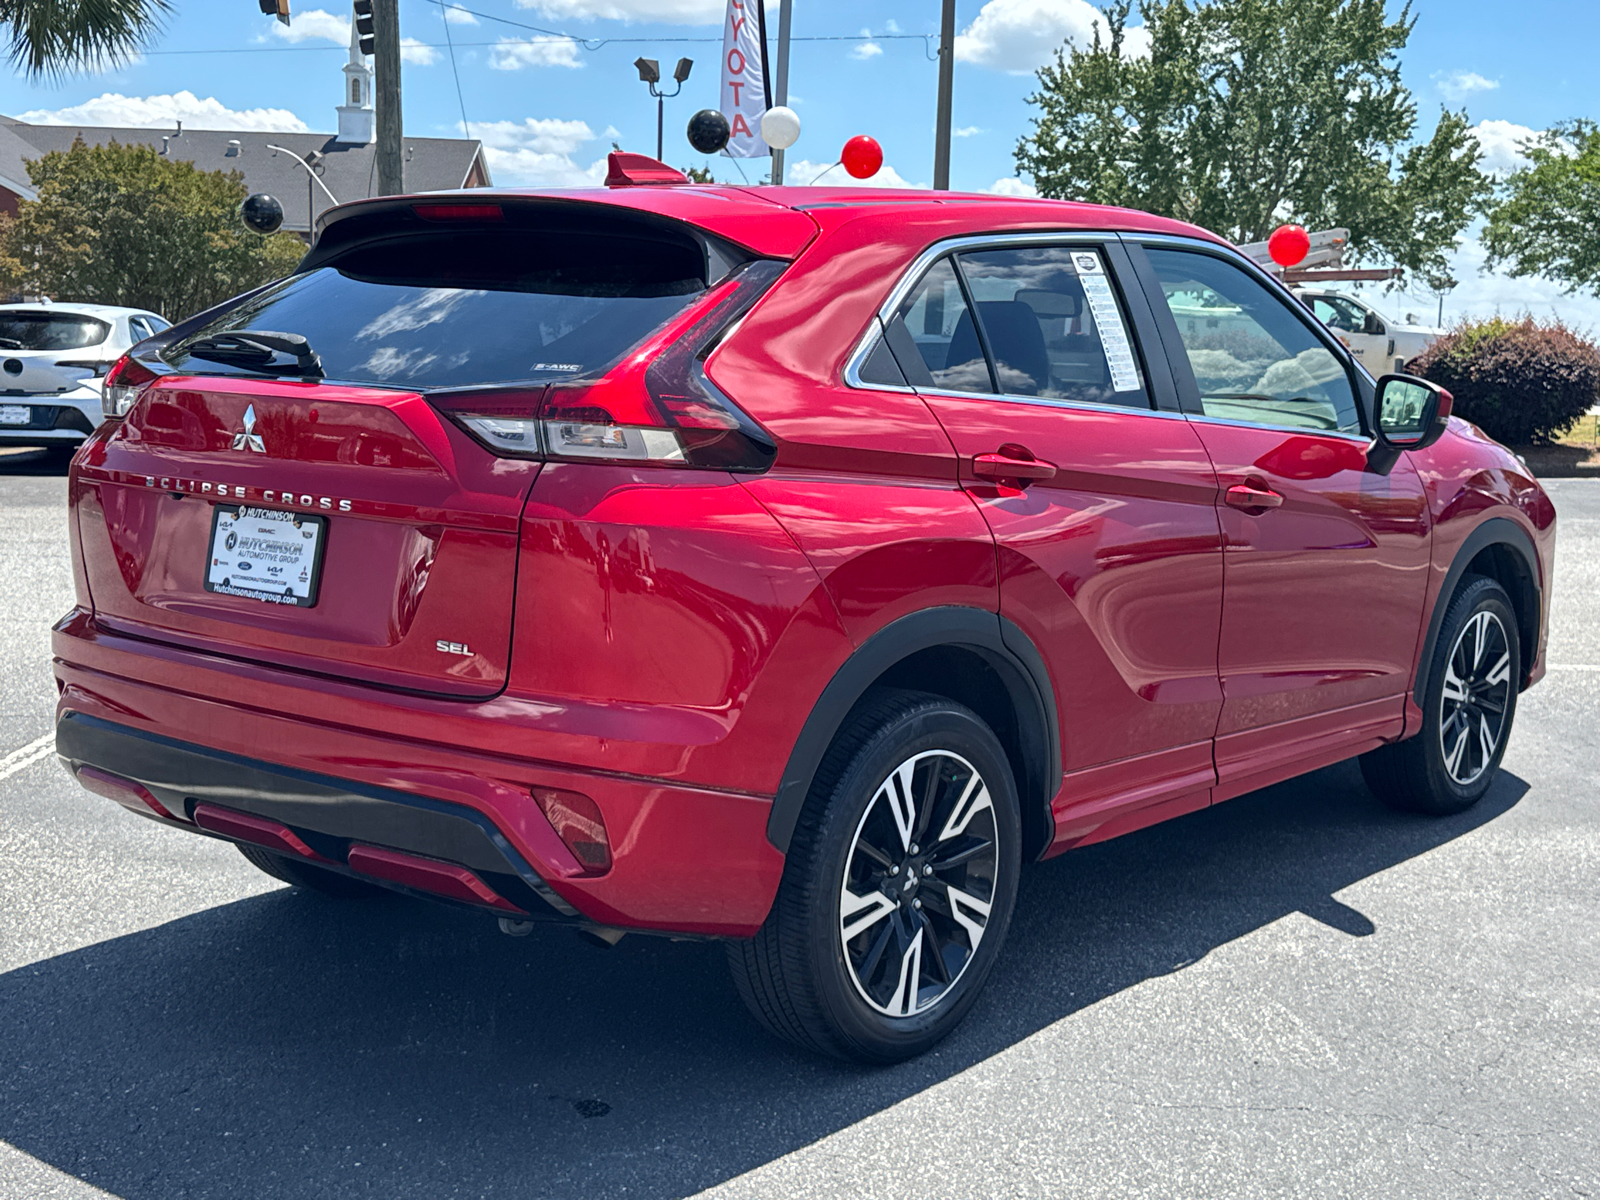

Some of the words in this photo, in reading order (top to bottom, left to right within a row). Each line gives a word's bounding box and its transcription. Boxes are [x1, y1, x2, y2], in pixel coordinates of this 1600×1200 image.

[145, 476, 246, 498] ECLIPSE
[263, 490, 352, 512] CROSS
[247, 507, 295, 522] HUTCHINSON
[238, 536, 303, 555] HUTCHINSON
[237, 550, 277, 562] AUTOMOTIVE
[279, 554, 299, 564] GROUP
[213, 583, 298, 604] Hutchinsonautogroup.com
[436, 639, 475, 657] SEL
